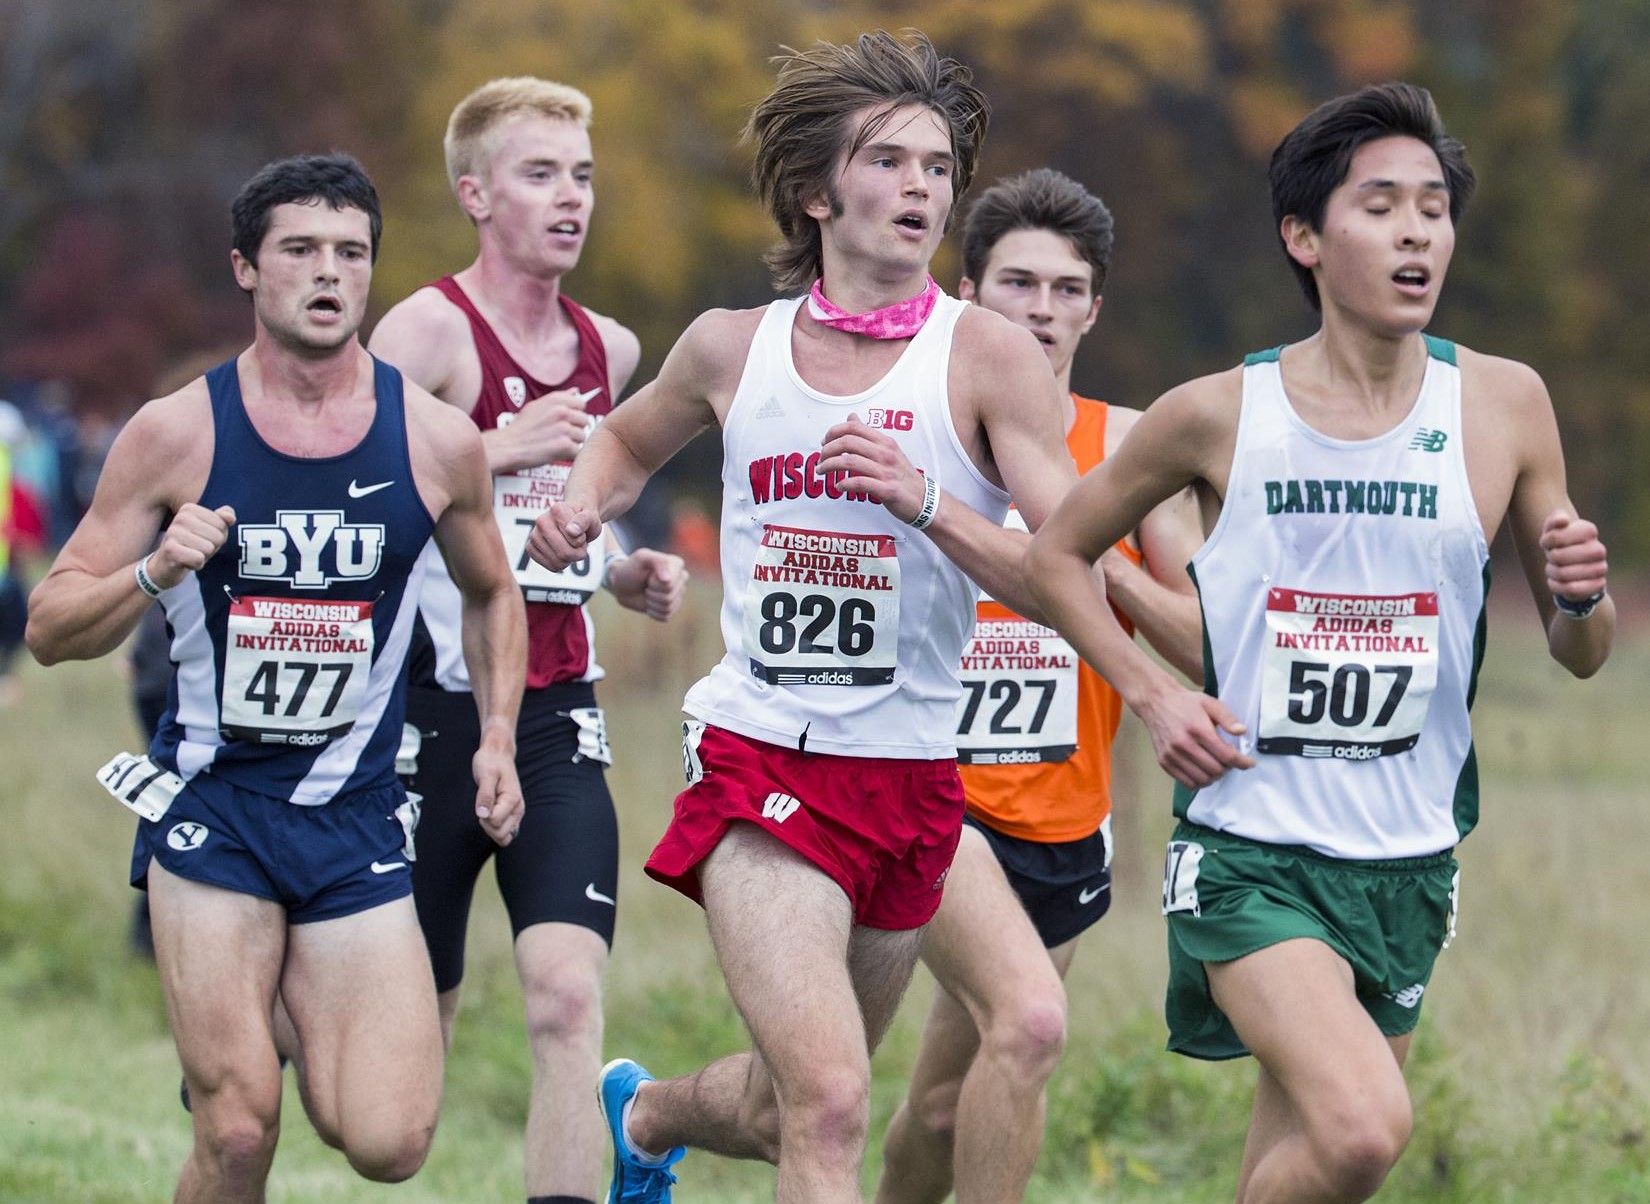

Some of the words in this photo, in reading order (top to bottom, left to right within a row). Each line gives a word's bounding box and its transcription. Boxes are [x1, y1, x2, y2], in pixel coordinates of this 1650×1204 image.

[1264, 480, 1438, 519] DARTMOUTH
[238, 510, 385, 589] BYU
[767, 531, 879, 557] WISCONSIN
[782, 552, 859, 573] ADIDAS
[754, 564, 893, 591] INVITATIONAL
[546, 591, 582, 605] adidas
[1293, 595, 1417, 616] WISCONSIN
[253, 601, 361, 622] WISCONSIN
[269, 622, 340, 638] ADIDAS
[759, 592, 876, 657] 826
[1312, 617, 1394, 634] ADIDAS
[236, 634, 367, 654] INVITATIONAL
[972, 640, 1040, 654] ADIDAS
[1275, 632, 1429, 653] INVITATIONAL
[960, 655, 1071, 670] VITATIONAL
[807, 671, 853, 685] adidas
[244, 660, 354, 718] 477
[1288, 660, 1413, 727] 507
[956, 679, 1057, 735] 727
[288, 732, 329, 746] adidas
[998, 751, 1041, 764] adidas
[1334, 744, 1382, 760] adidas
[762, 792, 800, 824] W
[172, 824, 204, 849] Y
